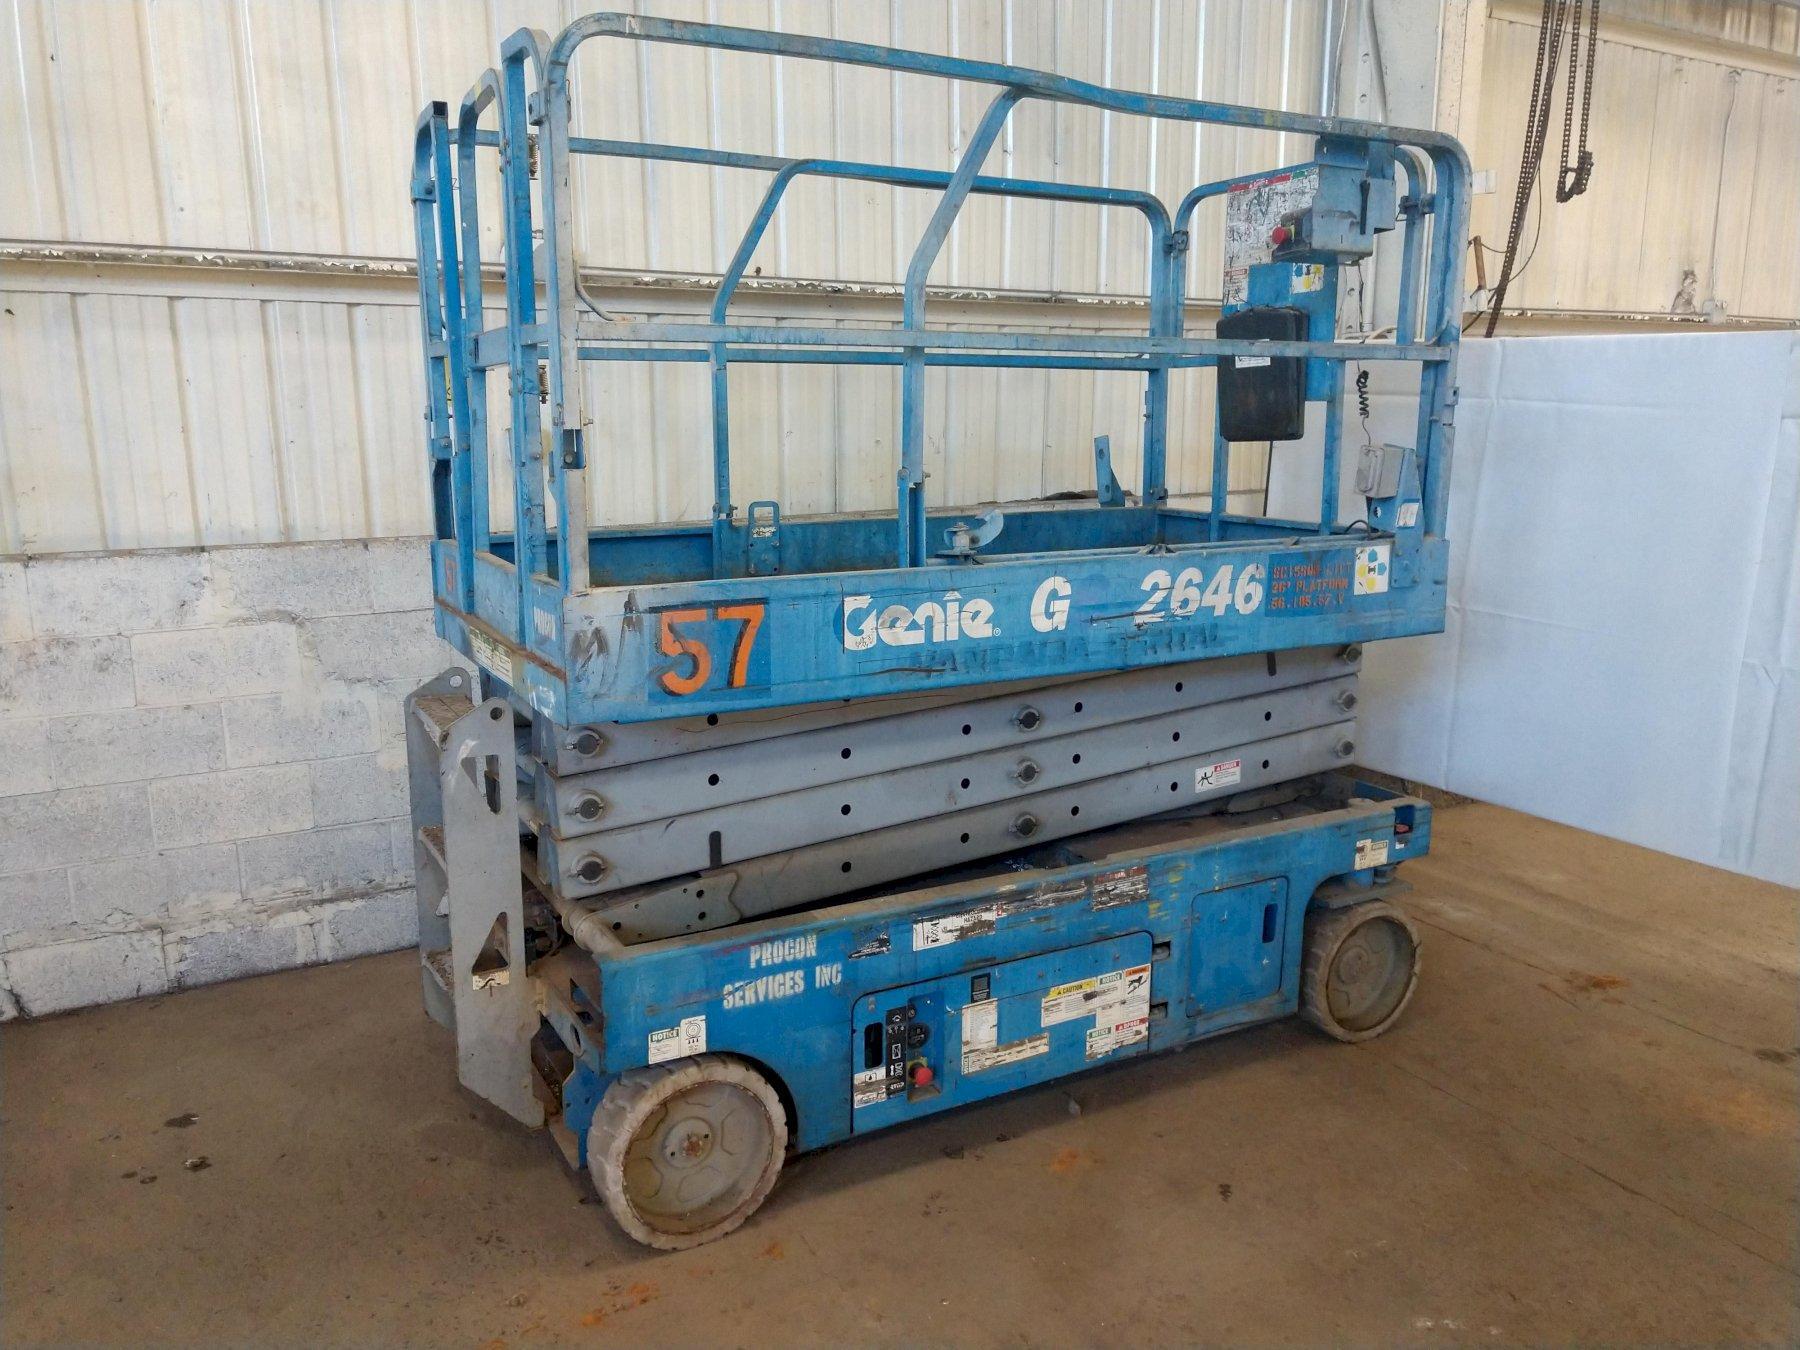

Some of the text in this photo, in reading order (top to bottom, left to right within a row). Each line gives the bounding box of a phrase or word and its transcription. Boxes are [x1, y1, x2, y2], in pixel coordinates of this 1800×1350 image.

[842, 590, 993, 651] Genie
[1029, 575, 1072, 633] G
[1133, 562, 1266, 627] 2646
[657, 603, 765, 696] 57
[749, 934, 818, 969] PROCON
[722, 962, 843, 1010] SERVICES INC
[1063, 984, 1083, 993] CAUTION
[652, 1029, 679, 1042] NOTICE
